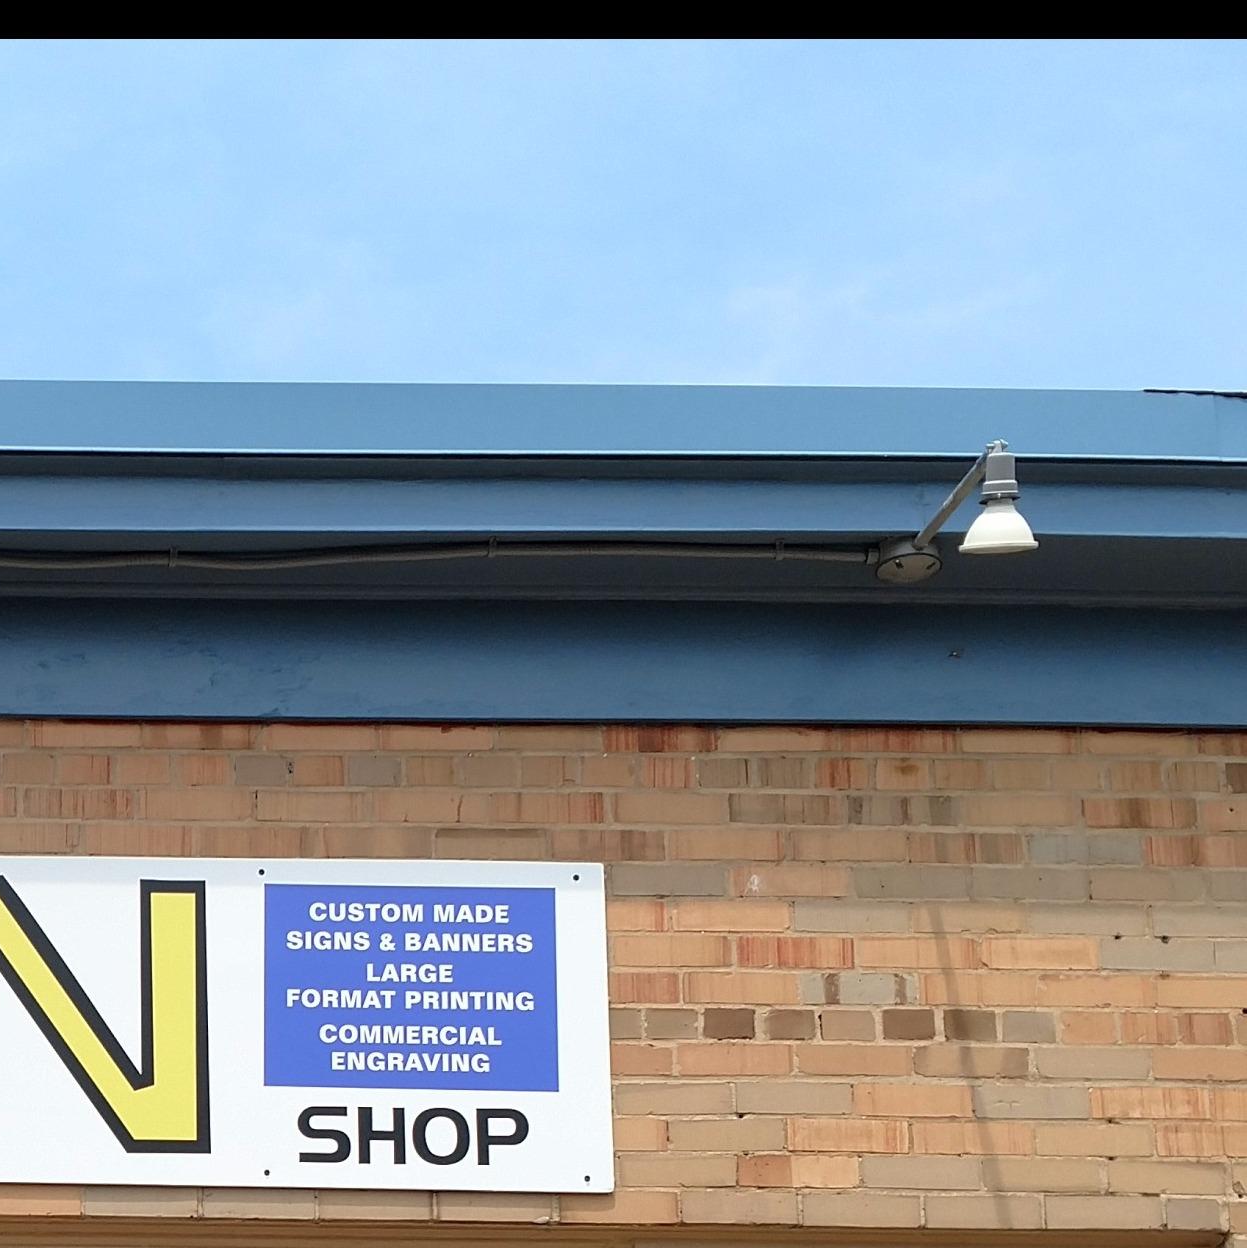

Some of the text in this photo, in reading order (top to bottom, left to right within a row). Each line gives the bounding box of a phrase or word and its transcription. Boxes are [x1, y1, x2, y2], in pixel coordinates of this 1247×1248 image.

[308, 902, 510, 924] CUSTOM MADE
[286, 930, 533, 953] SIGNS & BANNERS
[366, 963, 454, 983] LARGE
[286, 988, 535, 1012] FORMAT PRINTING
[318, 1024, 502, 1046] COMMERCIAL
[331, 1051, 491, 1073] ENGRAVING
[297, 1106, 530, 1166] SHOP
